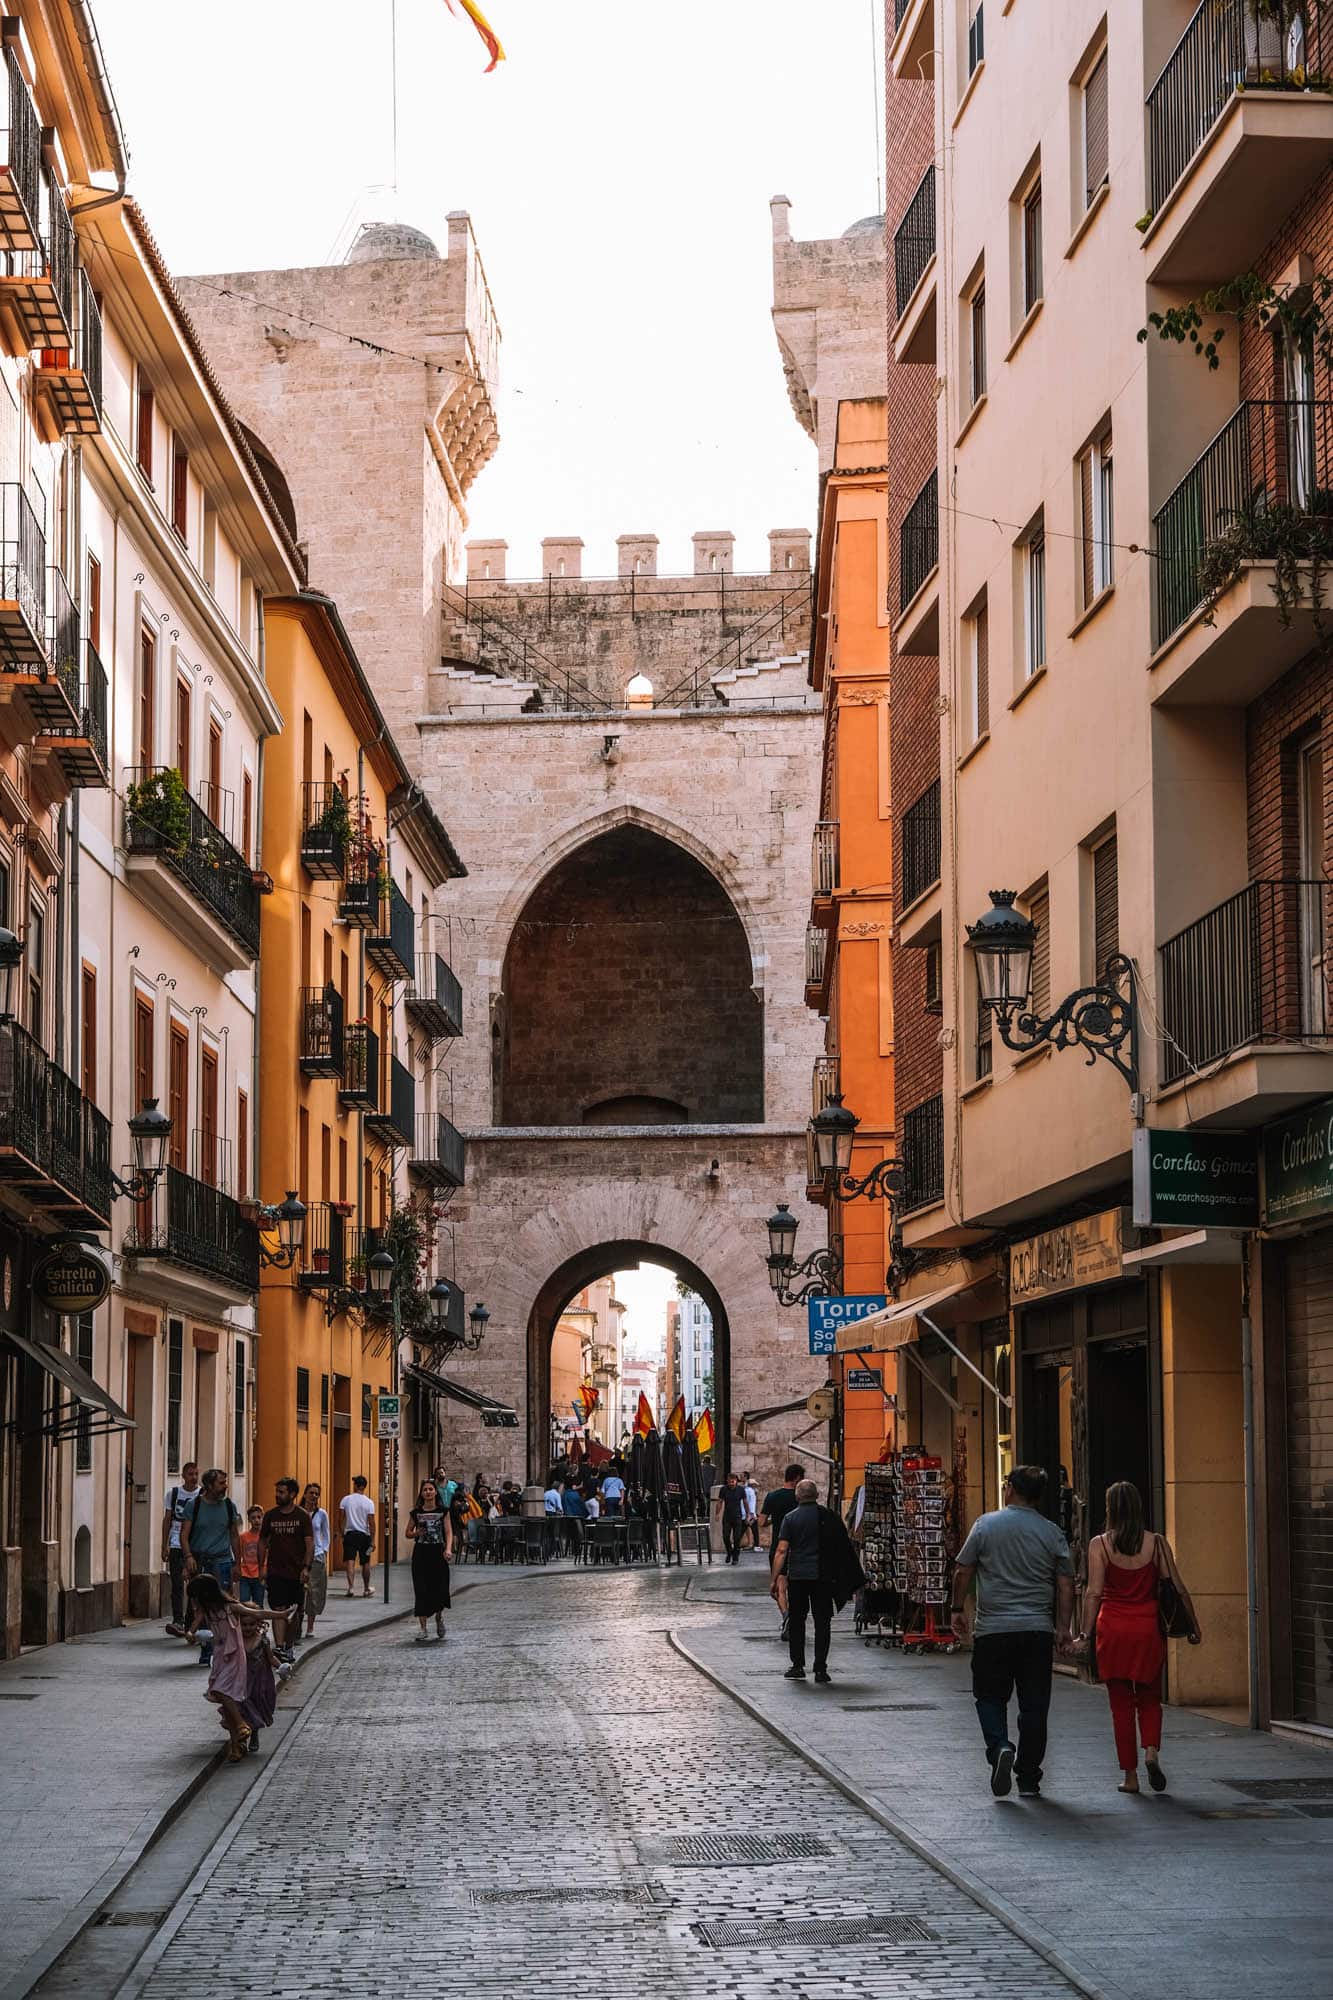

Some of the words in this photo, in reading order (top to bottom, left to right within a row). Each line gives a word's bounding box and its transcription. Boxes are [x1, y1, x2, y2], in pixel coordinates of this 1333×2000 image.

[1282, 1117, 1325, 1172] Corchos
[1152, 1152, 1207, 1172] Corchos
[47, 1267, 97, 1280] Estrella
[47, 1279, 95, 1294] Galicia
[814, 1300, 880, 1317] Torre
